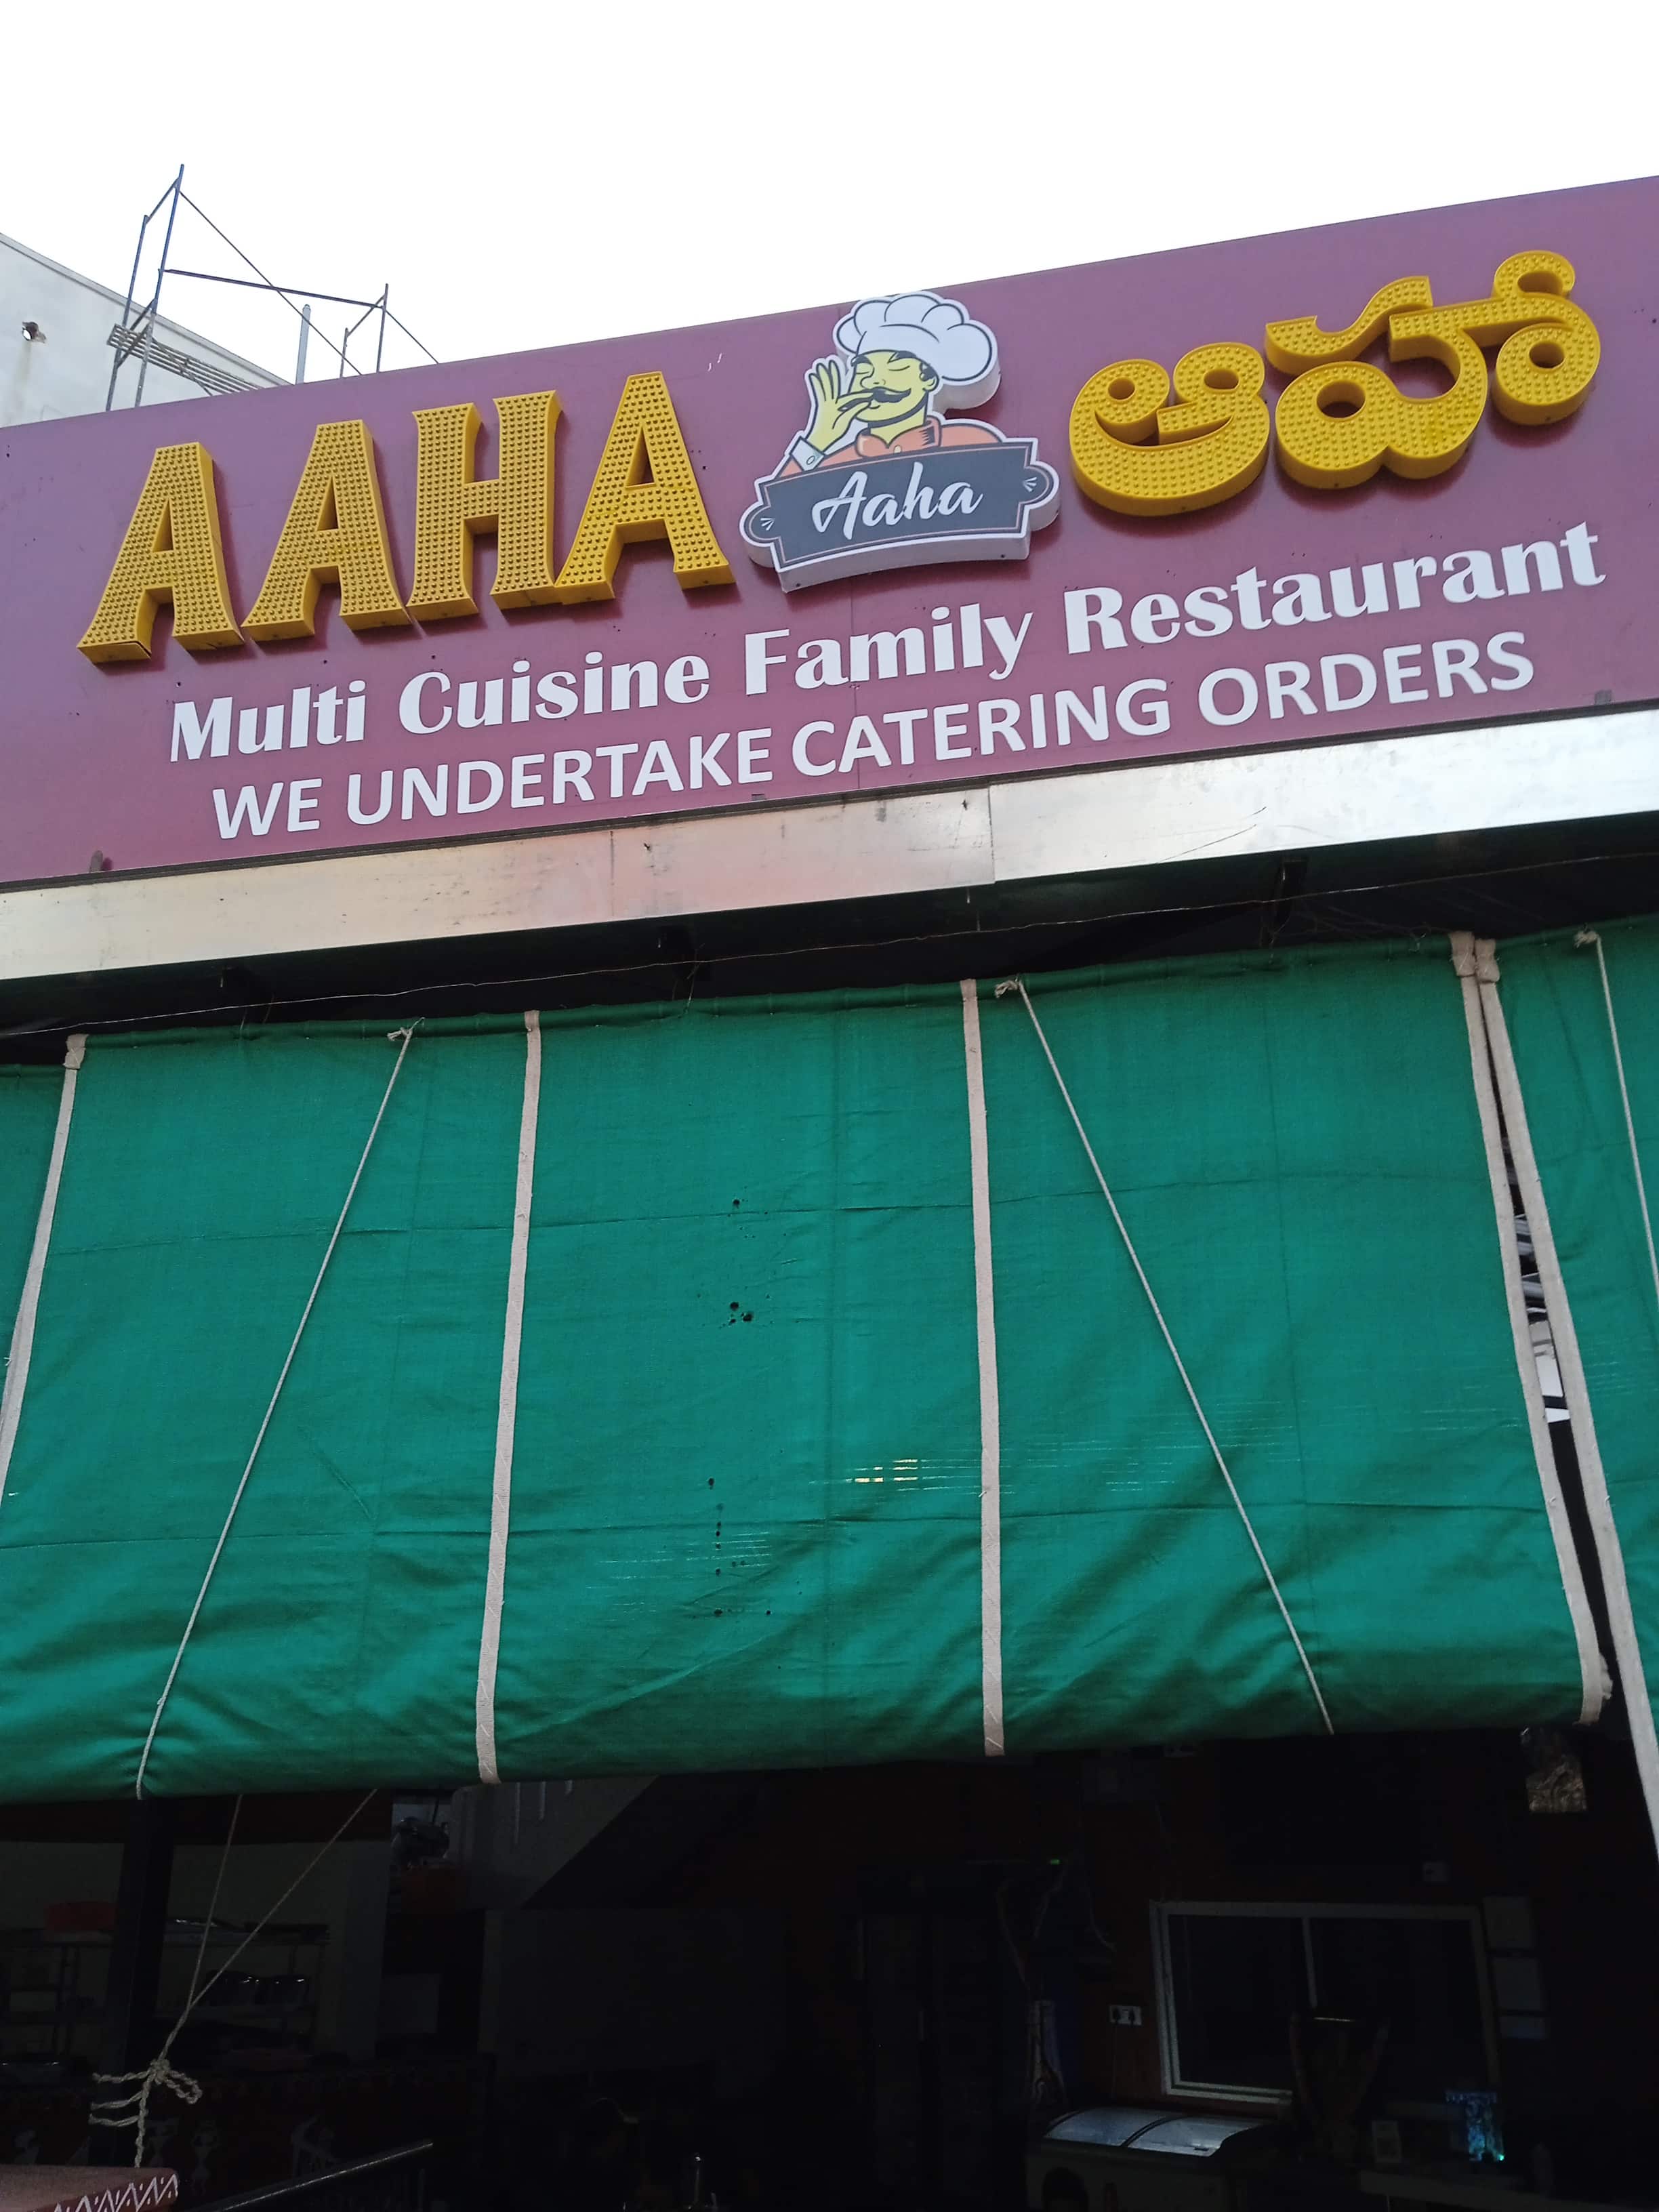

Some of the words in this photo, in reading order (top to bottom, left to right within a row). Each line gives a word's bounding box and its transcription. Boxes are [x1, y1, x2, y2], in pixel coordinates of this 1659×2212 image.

[812, 462, 983, 540] Aaha
[1069, 250, 1601, 516] ఆహా
[77, 371, 737, 663] AAHA
[170, 680, 367, 762] Multi
[398, 651, 710, 734] Cuisine
[745, 603, 1033, 695] Family
[1063, 521, 1607, 655] Restaurant
[212, 778, 323, 839] WE
[347, 727, 773, 825] UNDERTAKE
[792, 678, 1170, 777] CATERING
[1198, 631, 1534, 726] ORDERS
